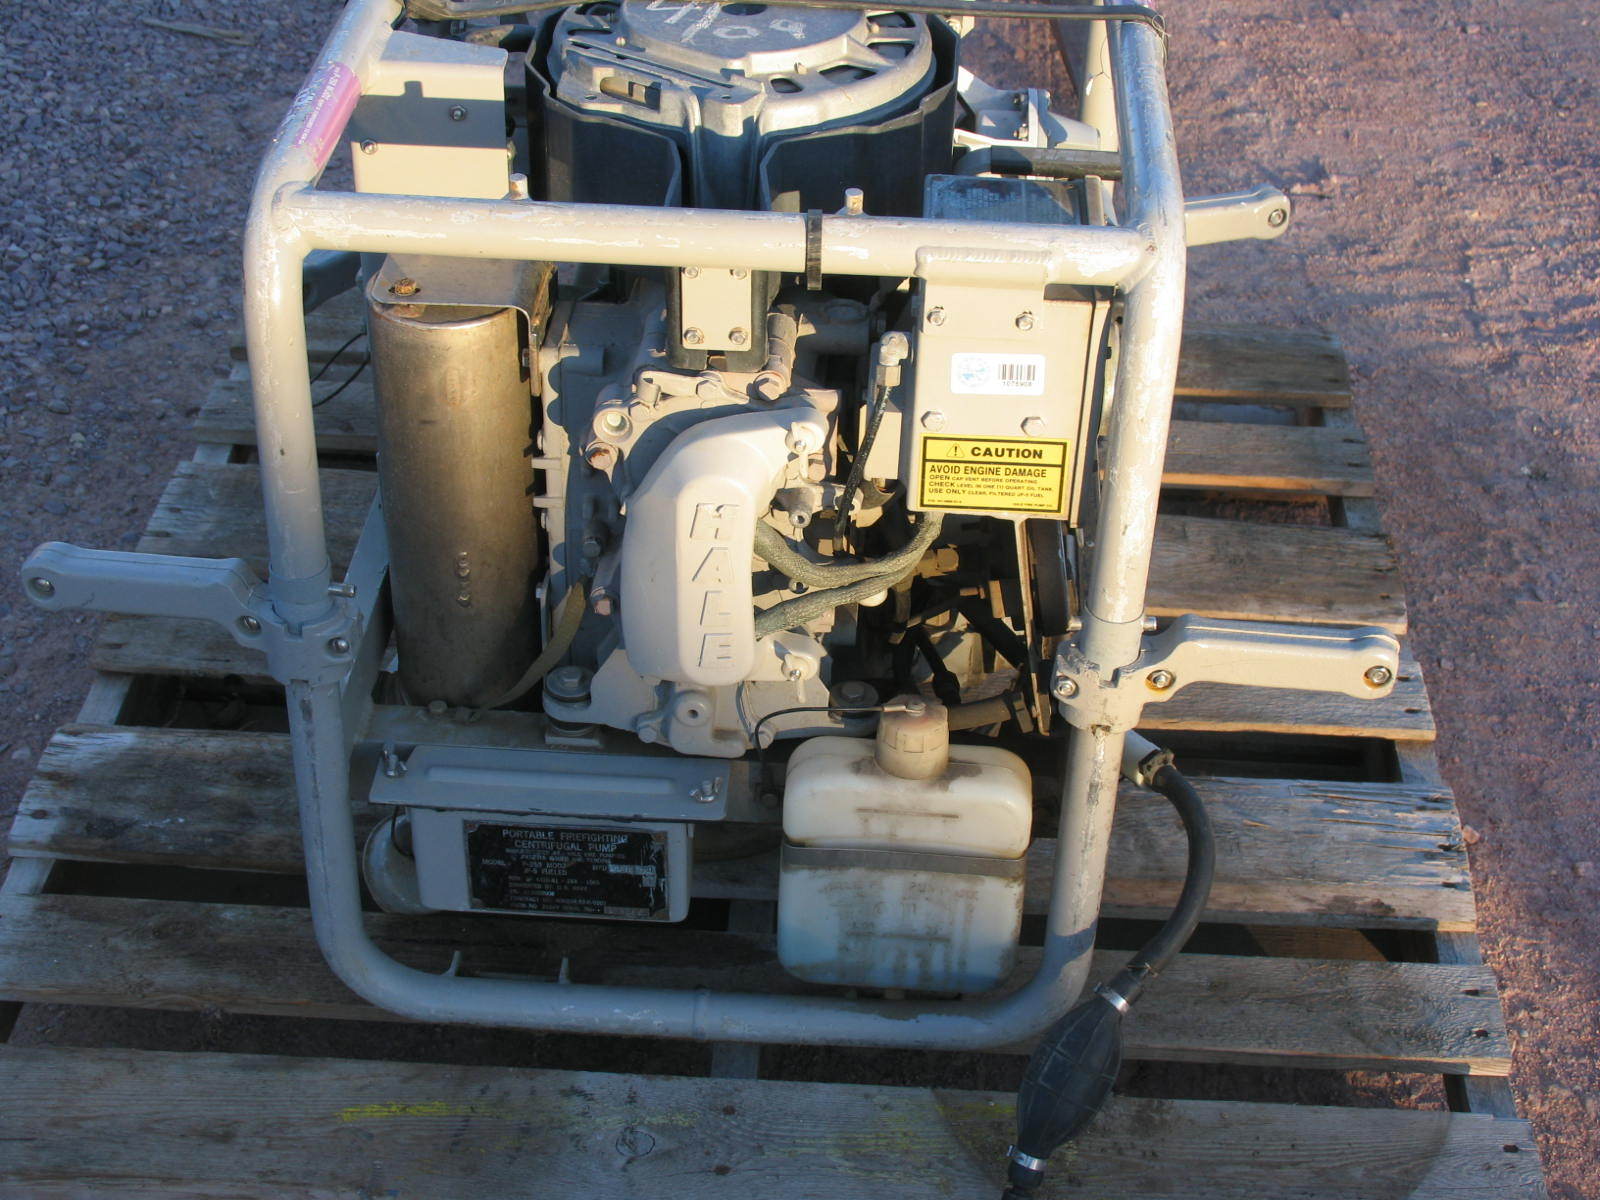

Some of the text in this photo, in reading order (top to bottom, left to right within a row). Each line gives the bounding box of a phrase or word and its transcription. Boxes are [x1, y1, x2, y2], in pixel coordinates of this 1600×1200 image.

[971, 446, 1043, 459] CAUTION
[929, 464, 1047, 478] AVOID ENGINE DAMAGE
[689, 502, 740, 668] HALE
[502, 829, 555, 840] PORTABLE
[514, 840, 583, 852] CENTRIFUGAL
[588, 842, 618, 853] PUMP
